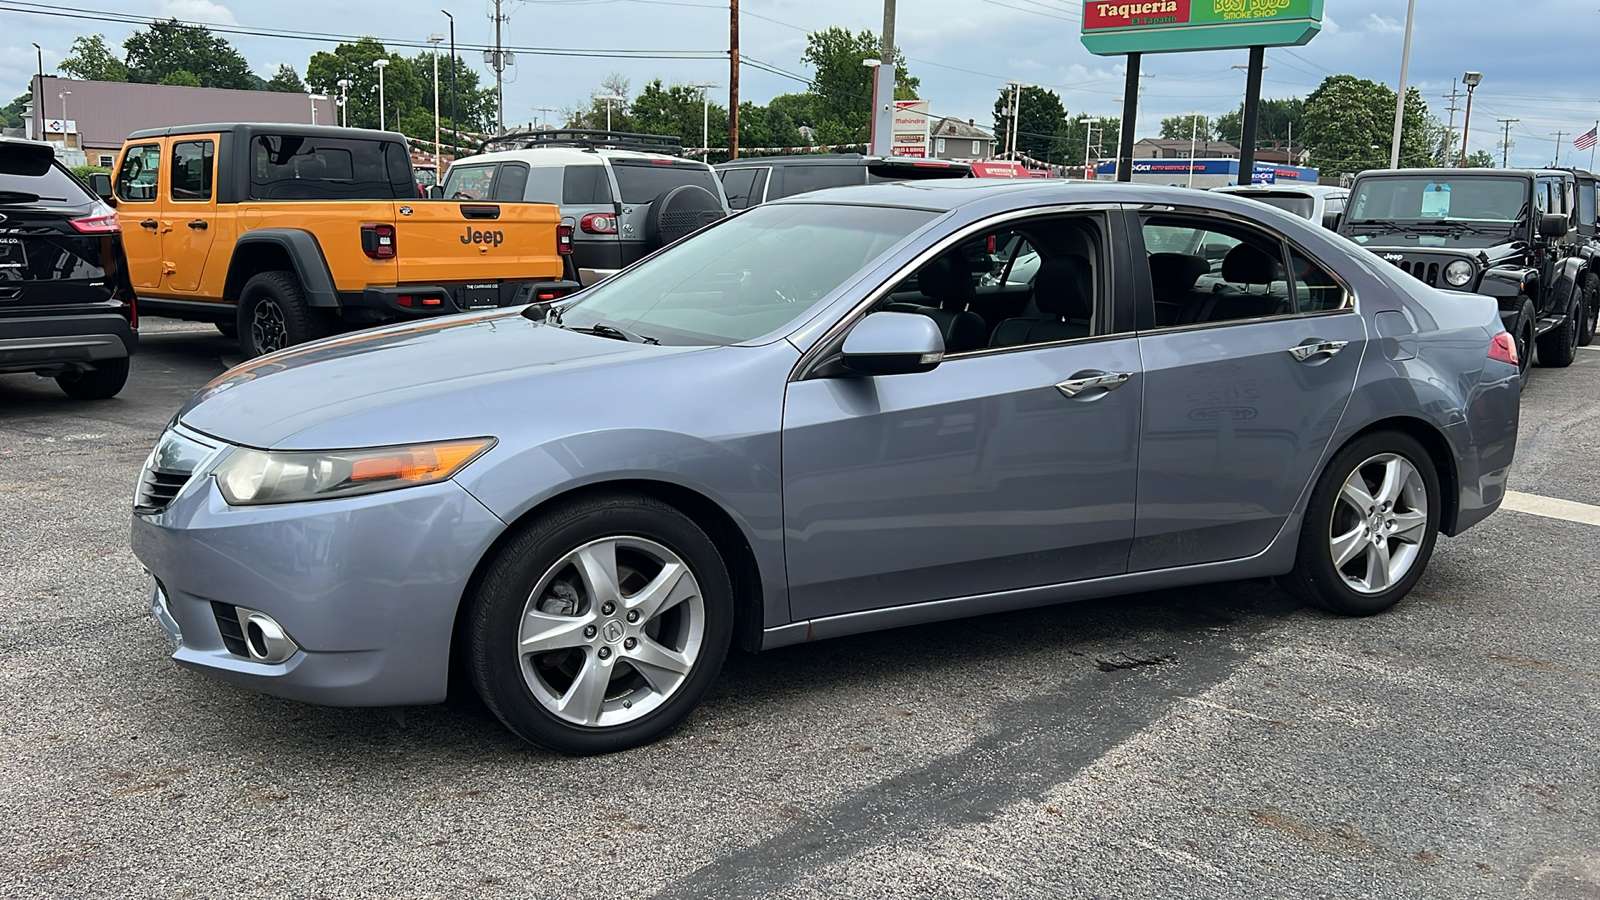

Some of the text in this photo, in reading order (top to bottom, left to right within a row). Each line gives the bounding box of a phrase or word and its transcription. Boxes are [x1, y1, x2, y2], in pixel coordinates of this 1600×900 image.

[1097, 0, 1177, 19] Taqueria
[1223, 9, 1278, 20] SMOKE SHOP
[1142, 15, 1177, 24] Tapatio
[460, 226, 504, 248] Jeep
[1383, 253, 1403, 261] Jeep
